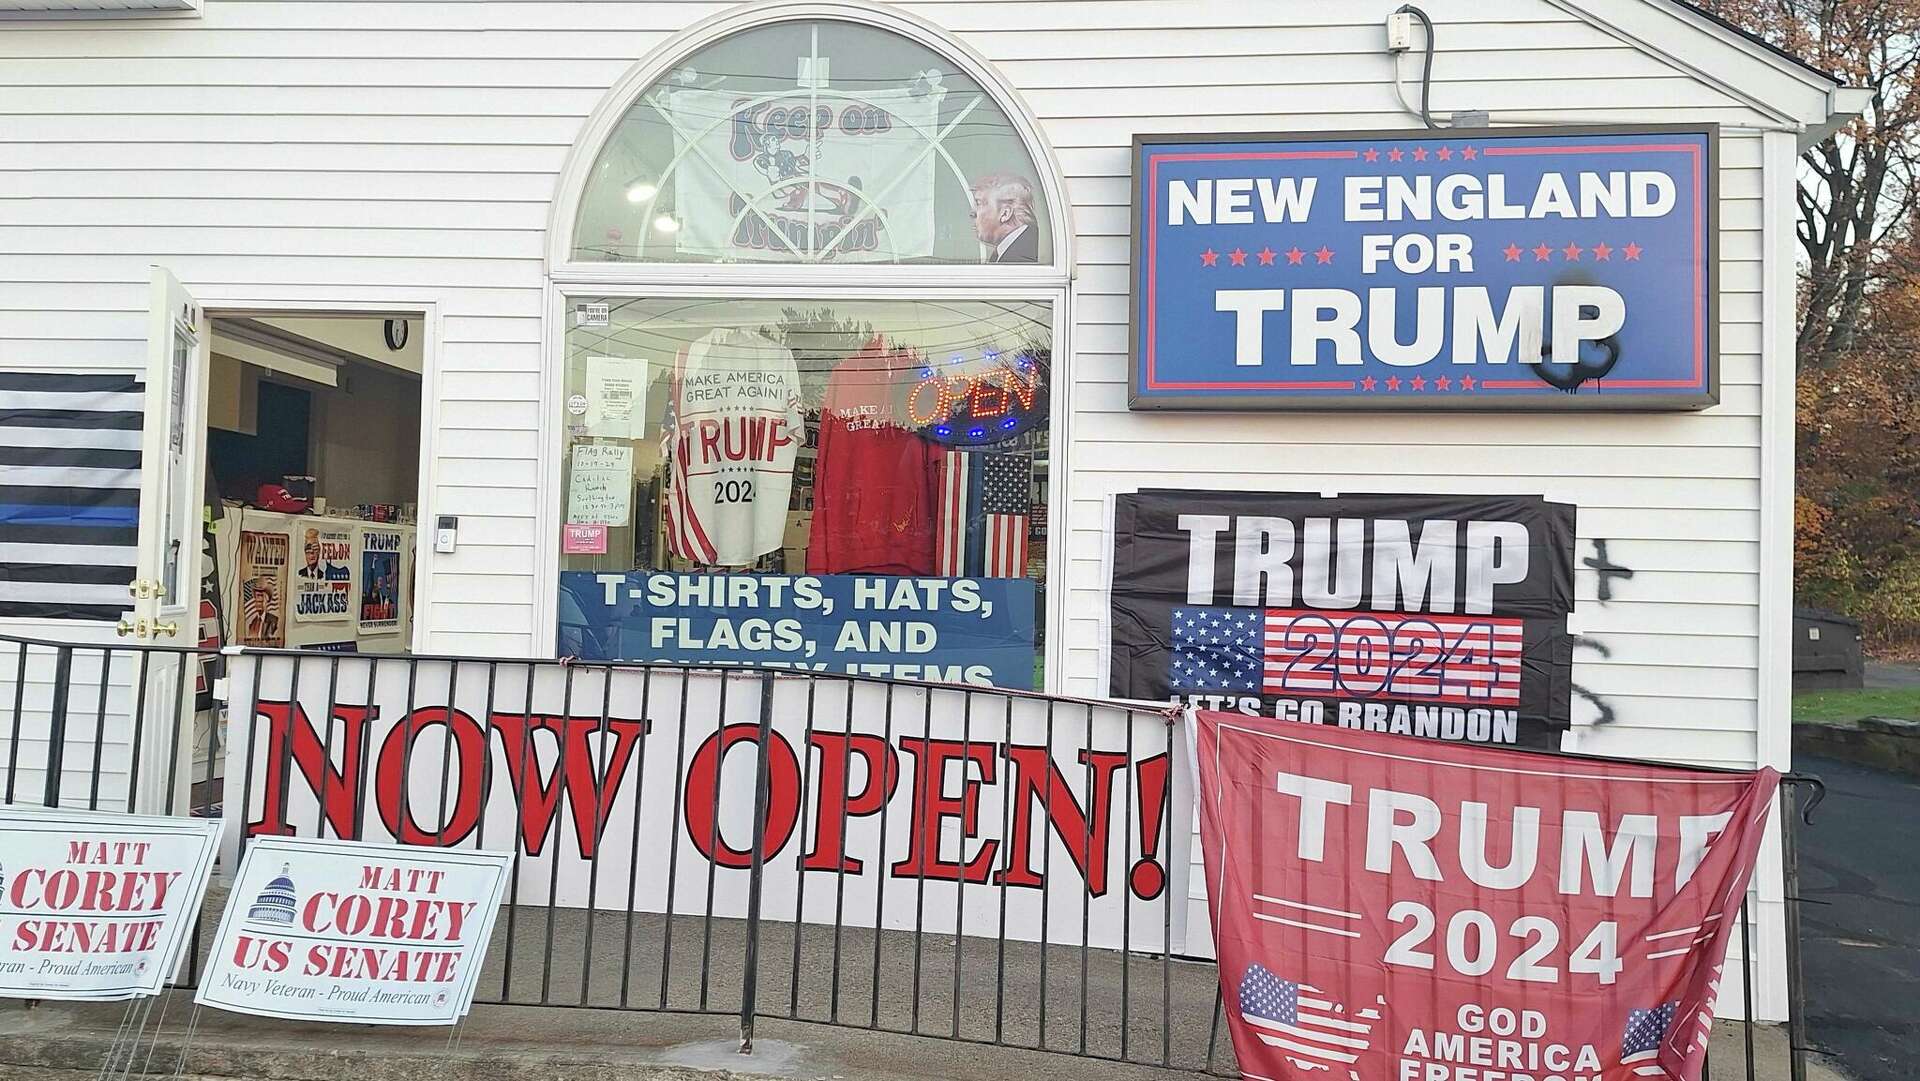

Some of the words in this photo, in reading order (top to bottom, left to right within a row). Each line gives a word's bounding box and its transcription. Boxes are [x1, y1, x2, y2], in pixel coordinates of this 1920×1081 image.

[729, 97, 833, 162] Keep
[838, 104, 892, 136] on
[1168, 177, 1318, 225] NEW
[1344, 171, 1677, 222] ENGLAND
[1362, 233, 1475, 273] FOR
[1215, 285, 1626, 366] TRUMP
[685, 373, 721, 388] MAKE
[726, 372, 785, 386] AMERICA
[686, 386, 732, 403] GREAT
[908, 364, 1038, 426] OPEN
[840, 405, 878, 418] MAKE
[714, 480, 756, 504] 202
[322, 542, 350, 560] FELON
[363, 532, 401, 550] TRUMP
[570, 529, 601, 538] TRUMP
[1178, 515, 1530, 614] TRUMP
[297, 592, 348, 614] JACKASS
[597, 574, 834, 615] T-SHIRTS,
[854, 577, 994, 619] HATS,
[651, 617, 816, 658] FLAGS,
[834, 620, 938, 653] AND
[1282, 614, 1500, 700] 2024
[1169, 694, 1261, 717] T'S
[1275, 698, 1324, 724] GO
[1338, 702, 1518, 744] BRANDON
[247, 698, 653, 861] NOW
[684, 722, 1169, 901] OPEN!
[66, 841, 151, 865] MATT
[10, 868, 184, 912] COREY
[358, 865, 445, 894] MATT
[302, 891, 477, 941] COREY
[12, 920, 164, 954] SENATE
[1384, 901, 1624, 985] 2024
[38, 958, 79, 976] Proud
[81, 961, 134, 976] American
[232, 935, 294, 973] US
[303, 944, 464, 983] SENATE
[220, 973, 261, 997] Navy
[264, 979, 316, 1000] Veteran
[329, 984, 373, 1004] Proud
[372, 988, 431, 1005] American
[1457, 1003, 1548, 1039] GOD
[1400, 1059, 1604, 1081] FREE
[1403, 1028, 1602, 1072] AMERICA
